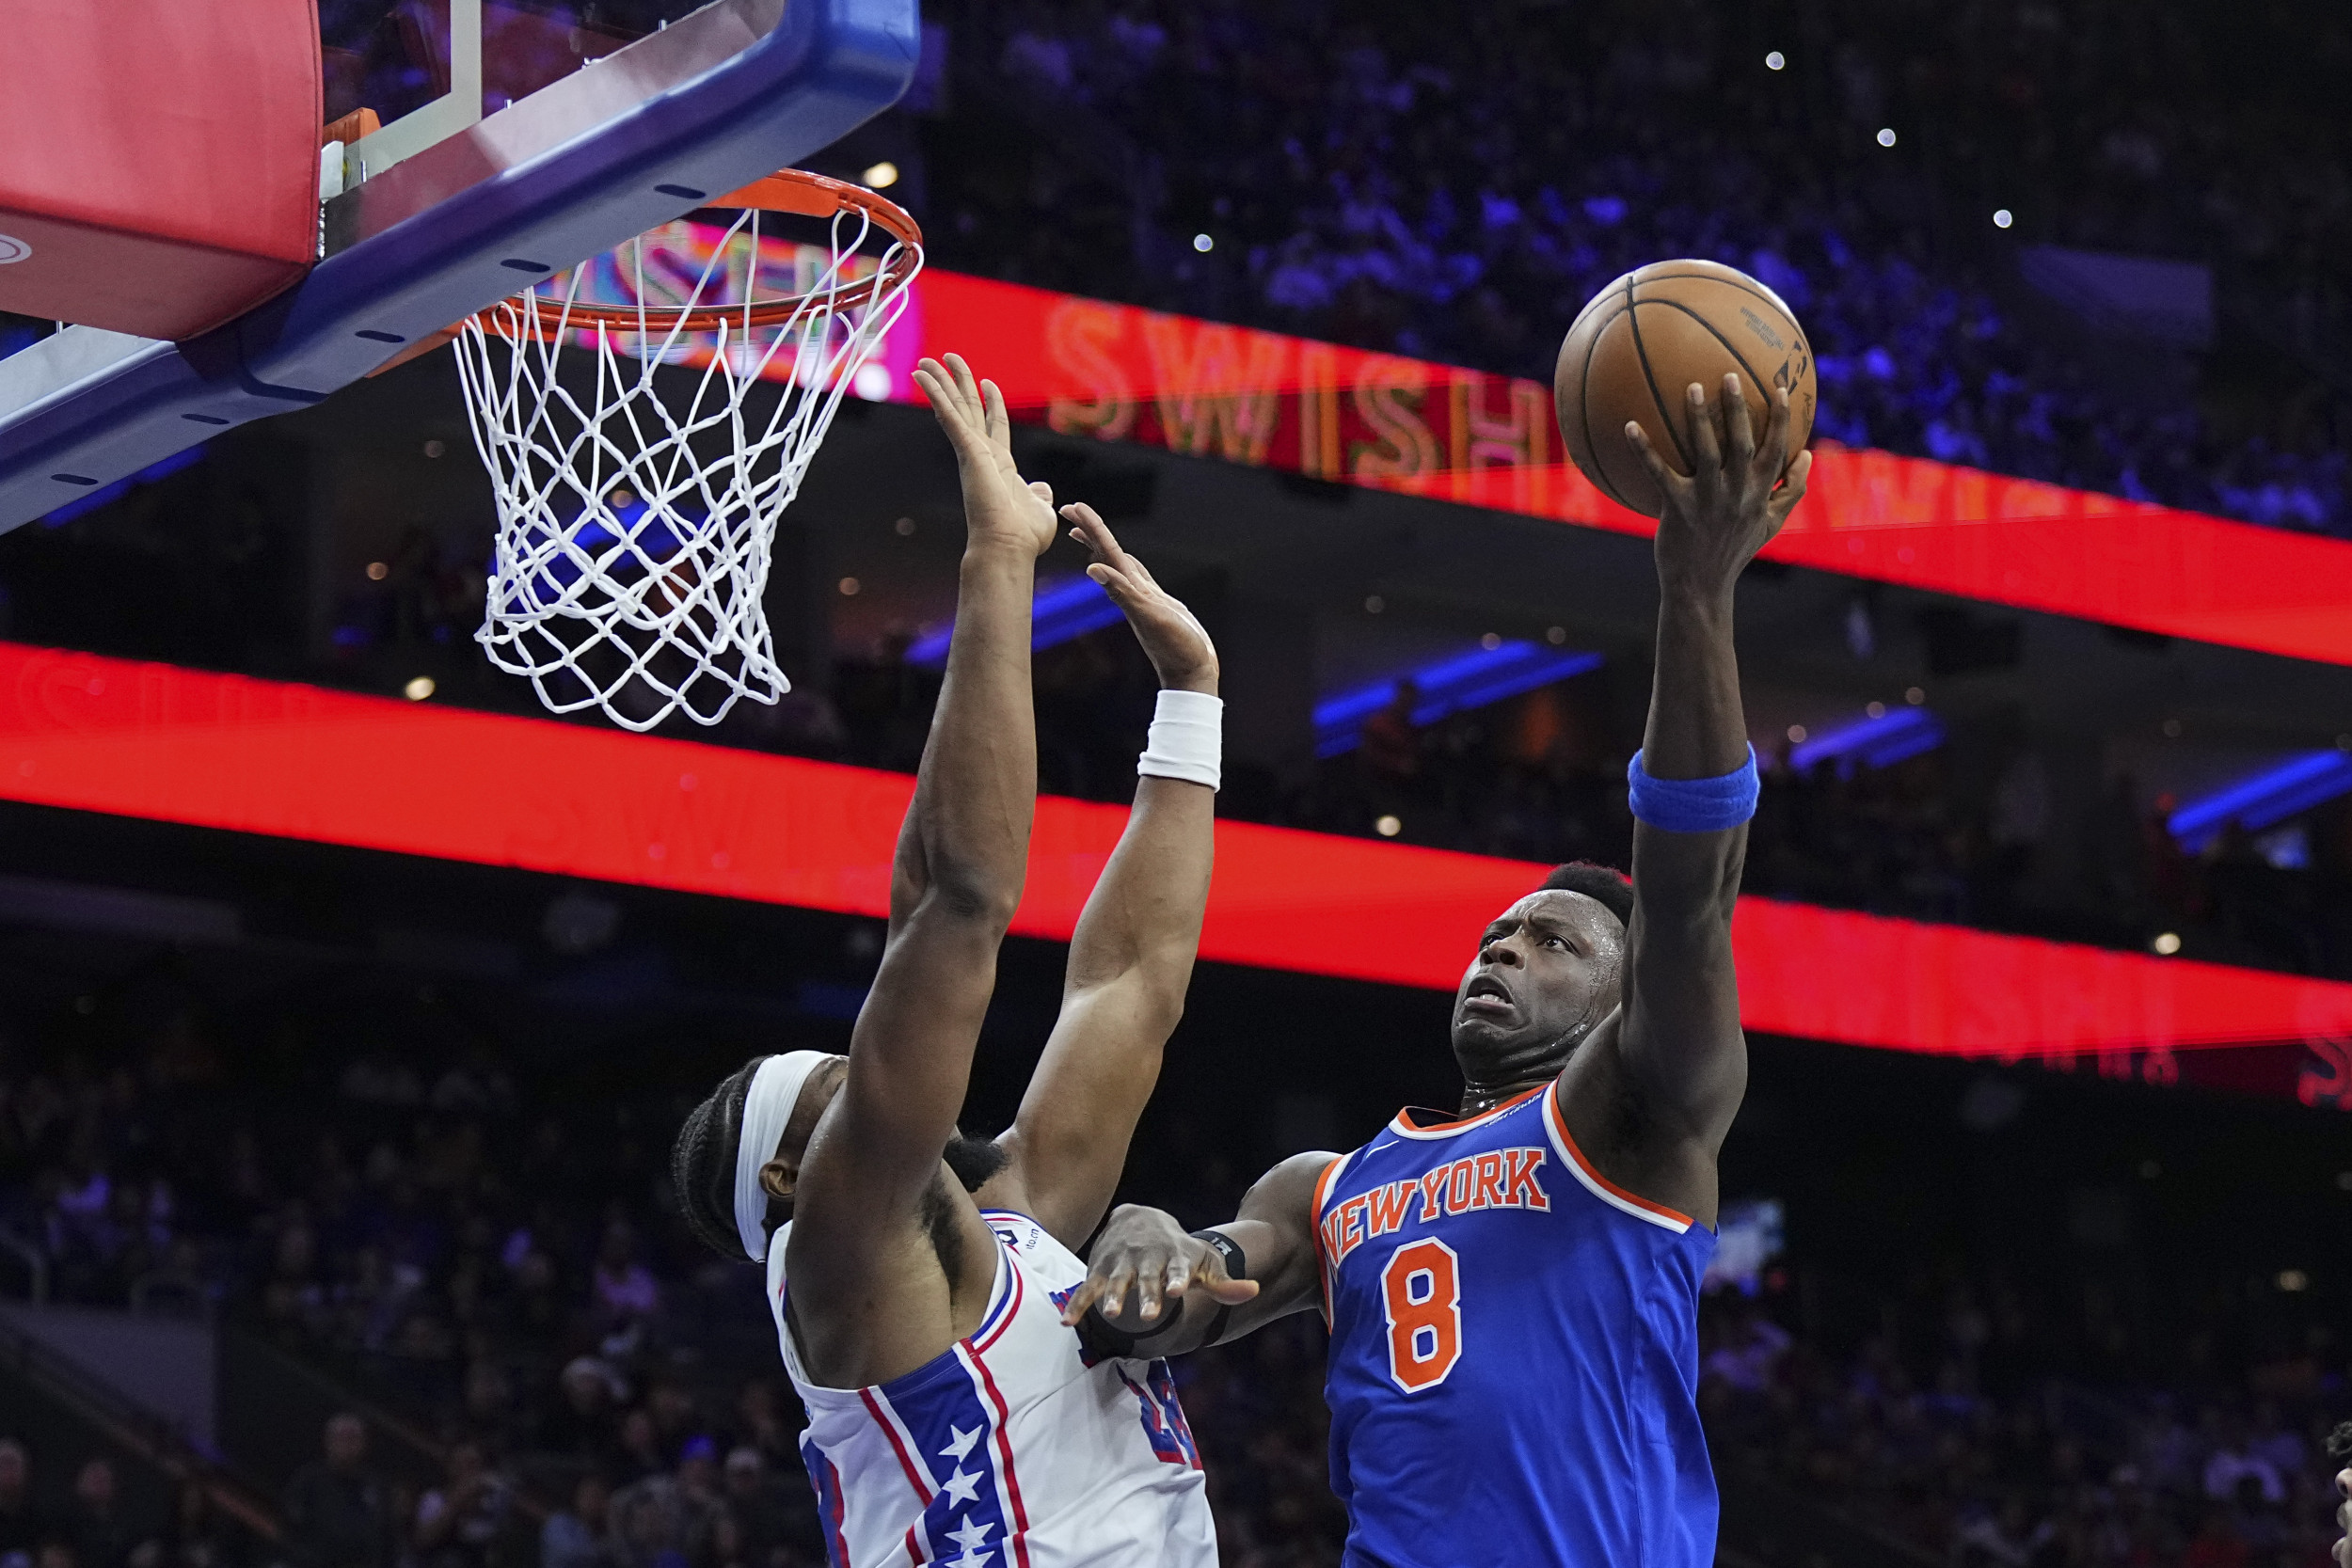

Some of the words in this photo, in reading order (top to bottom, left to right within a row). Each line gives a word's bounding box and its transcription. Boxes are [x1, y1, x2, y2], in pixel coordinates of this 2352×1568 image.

[1320, 1178, 1422, 1277] NEW
[1418, 1146, 1551, 1224] YORK
[1380, 1235, 1462, 1395] 8
